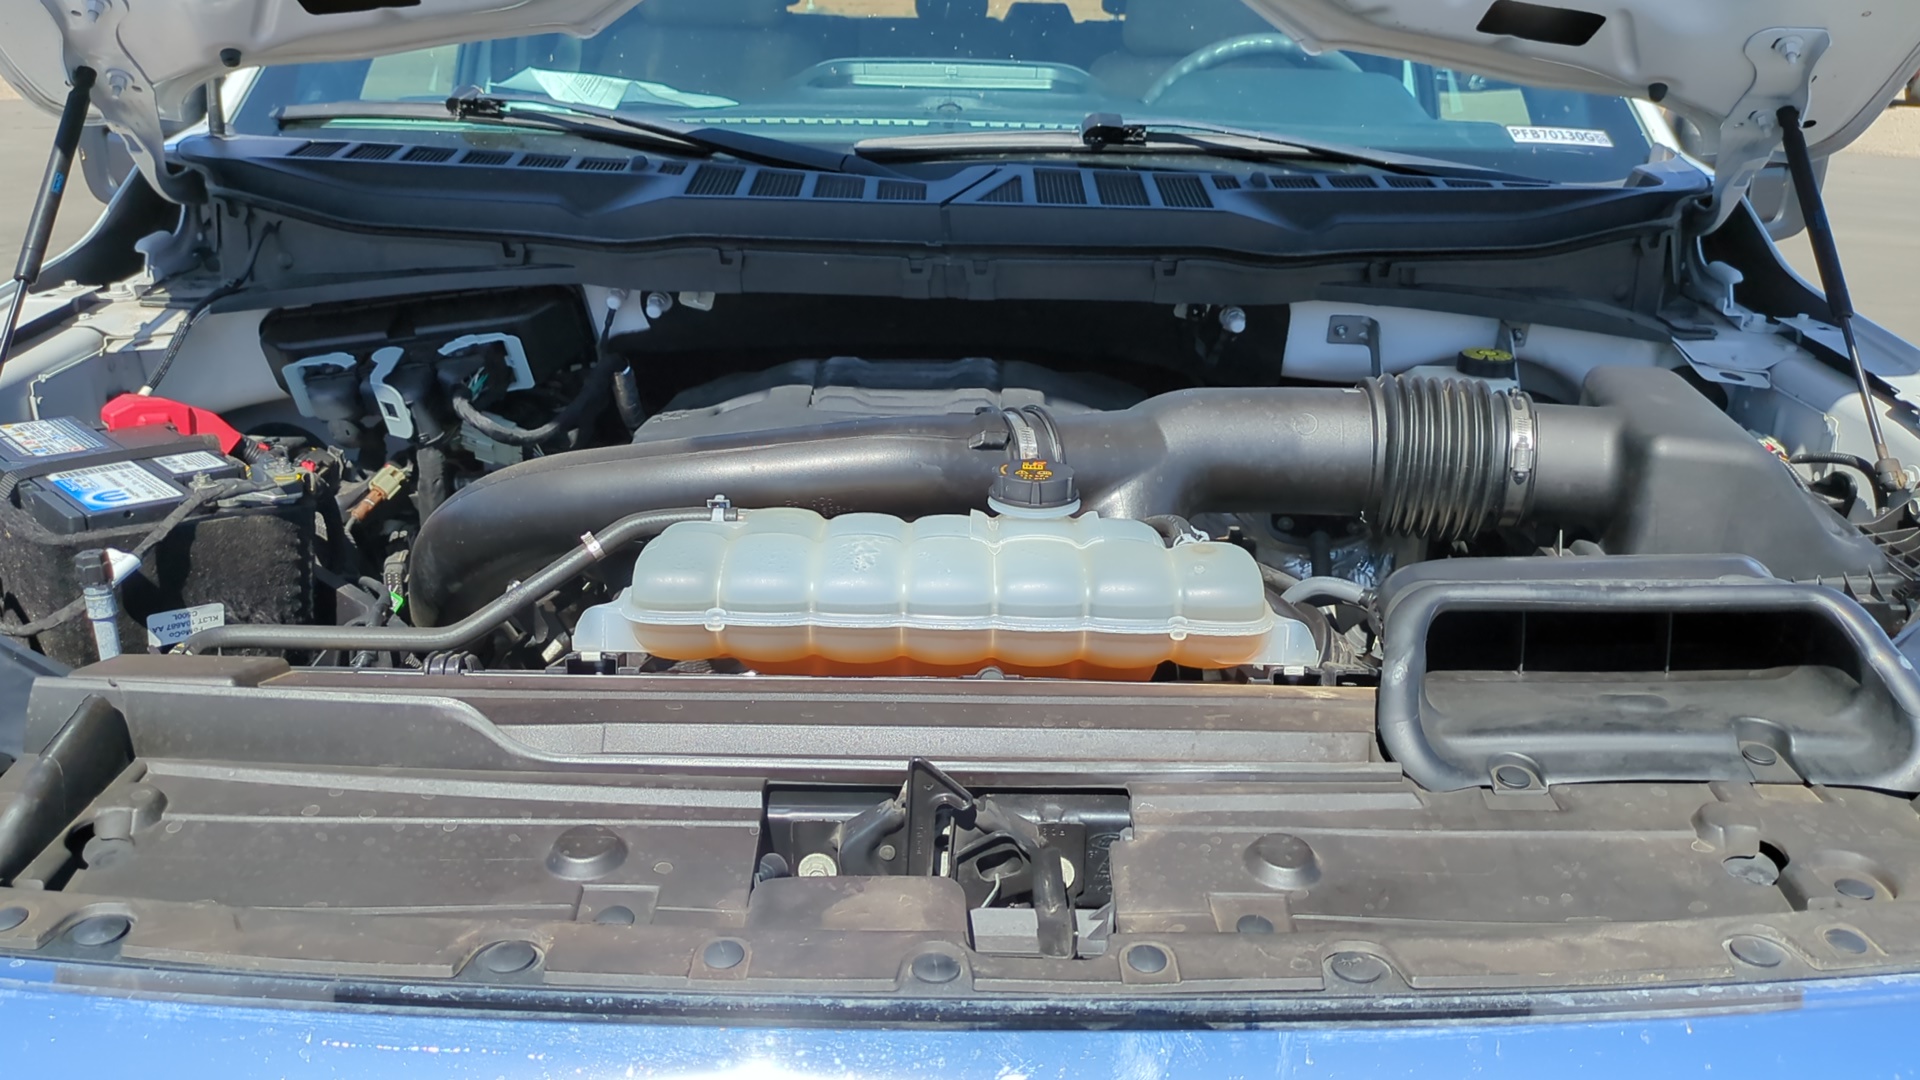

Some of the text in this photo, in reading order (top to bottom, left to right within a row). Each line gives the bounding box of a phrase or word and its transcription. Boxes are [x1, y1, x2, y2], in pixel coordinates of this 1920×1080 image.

[1511, 128, 1595, 141] PFB70130G
[198, 615, 219, 625] KL3T
[151, 626, 165, 634] AA
